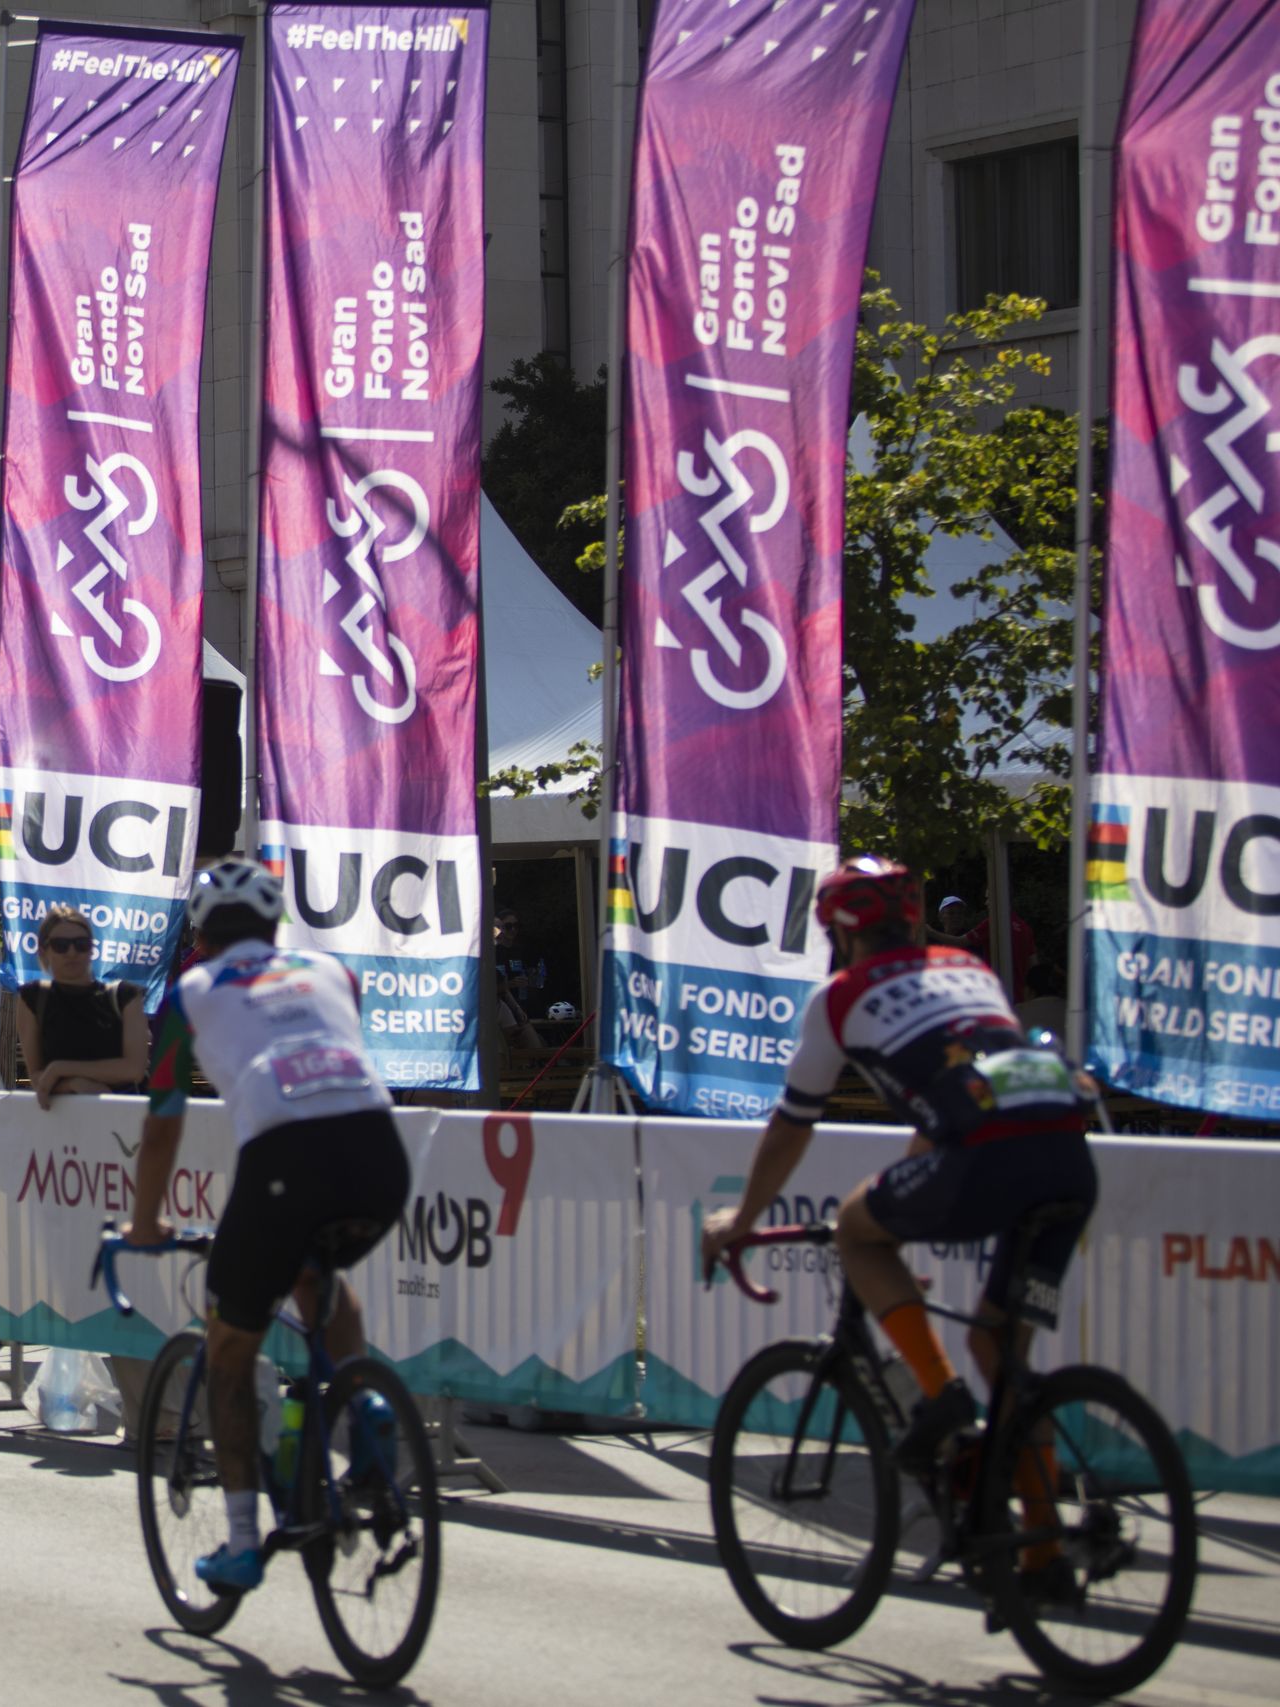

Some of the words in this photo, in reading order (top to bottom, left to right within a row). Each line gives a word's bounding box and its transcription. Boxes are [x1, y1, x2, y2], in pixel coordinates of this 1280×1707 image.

[287, 23, 458, 52] #FeelTheHill
[766, 144, 806, 236] Sad
[1196, 115, 1243, 243] Gran
[1244, 73, 1280, 246] Fondo
[125, 223, 153, 299] Sad
[399, 211, 426, 293] Sad
[694, 233, 722, 346] Gran
[726, 196, 760, 352] Fondo
[70, 294, 97, 387] Gran
[99, 265, 120, 392] Fondo
[363, 261, 394, 401] Fondo
[759, 246, 791, 357] Novi
[123, 303, 146, 396] Novi
[325, 296, 358, 400] Gran
[401, 305, 430, 401] Novi
[22, 790, 188, 879] UCI
[78, 903, 169, 934] FONDO
[291, 846, 464, 938] UCI
[629, 841, 818, 954] UCI
[361, 970, 464, 998] FONDO
[370, 1008, 465, 1034] SERIES
[680, 983, 796, 1024] FONDO
[385, 1060, 463, 1081] SERBIA
[688, 1026, 795, 1067] SERIES
